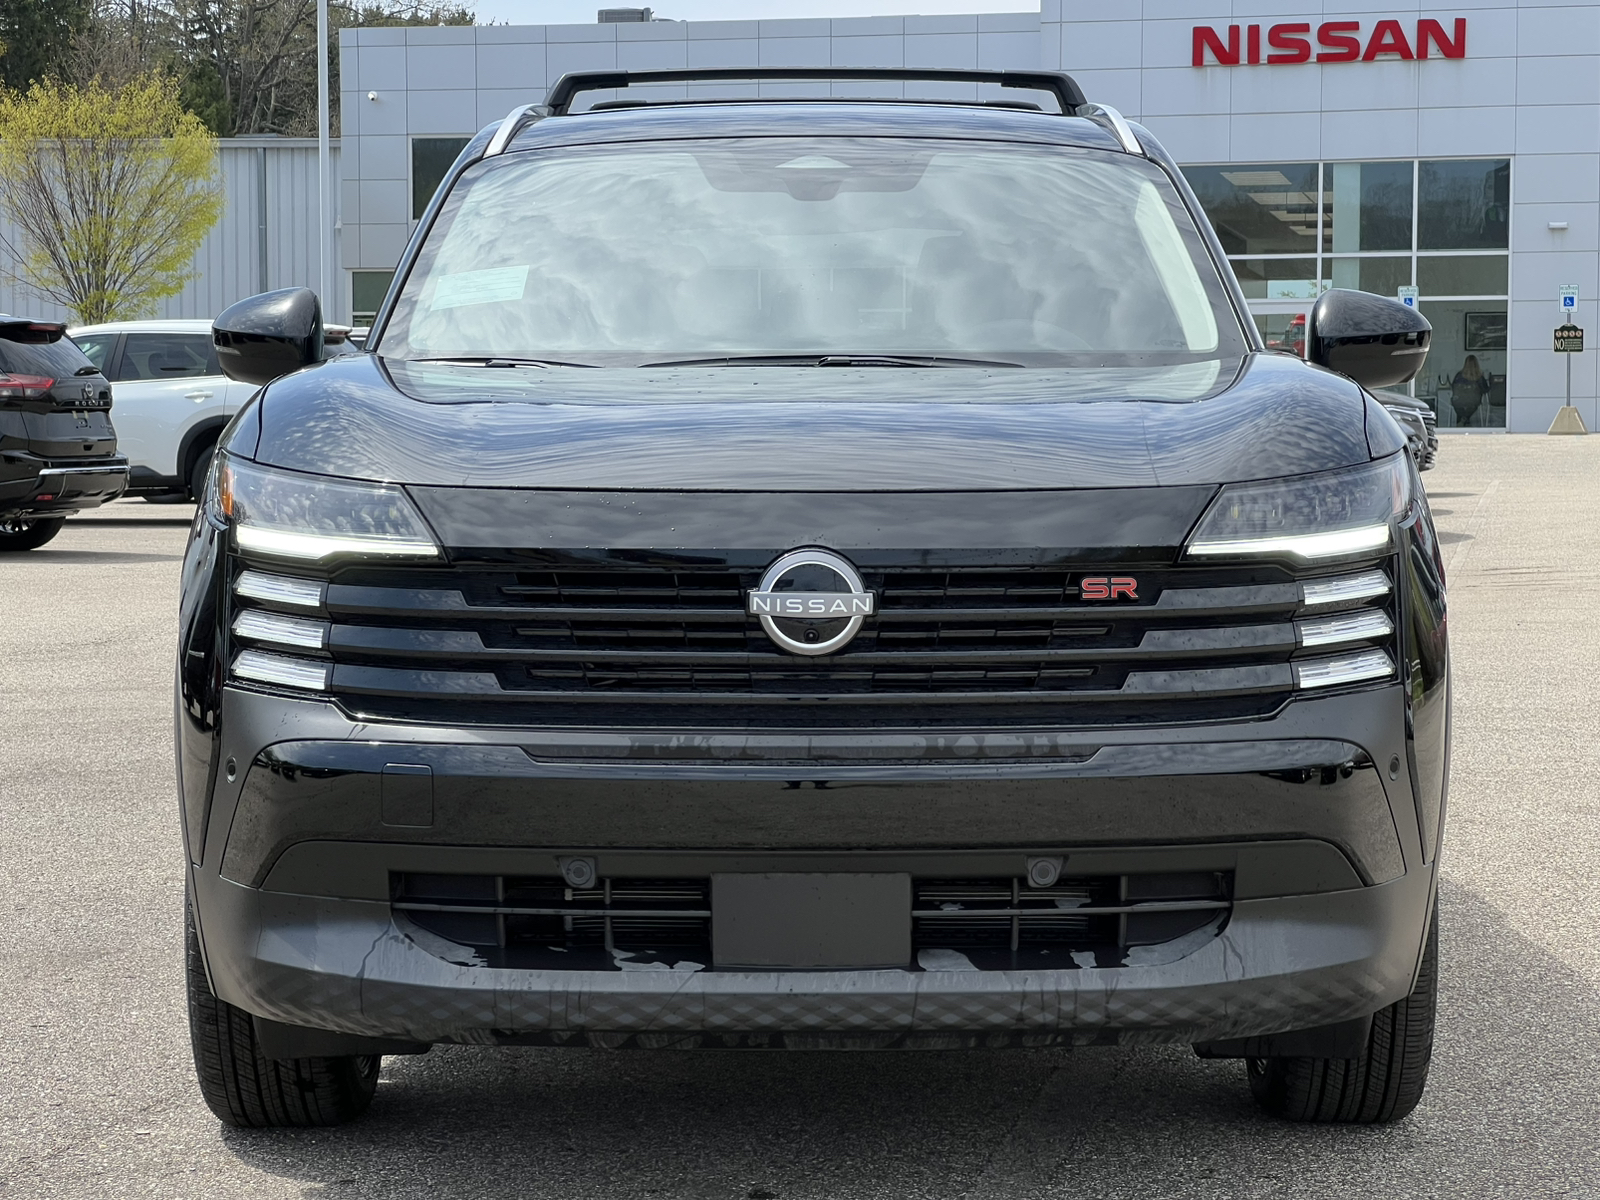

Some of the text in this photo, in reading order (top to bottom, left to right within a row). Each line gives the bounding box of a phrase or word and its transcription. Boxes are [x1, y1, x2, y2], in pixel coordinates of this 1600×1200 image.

[1192, 18, 1466, 67] NISSAN
[1554, 339, 1565, 350] NO
[1081, 577, 1139, 599] SR
[752, 596, 870, 613] NISSAN
